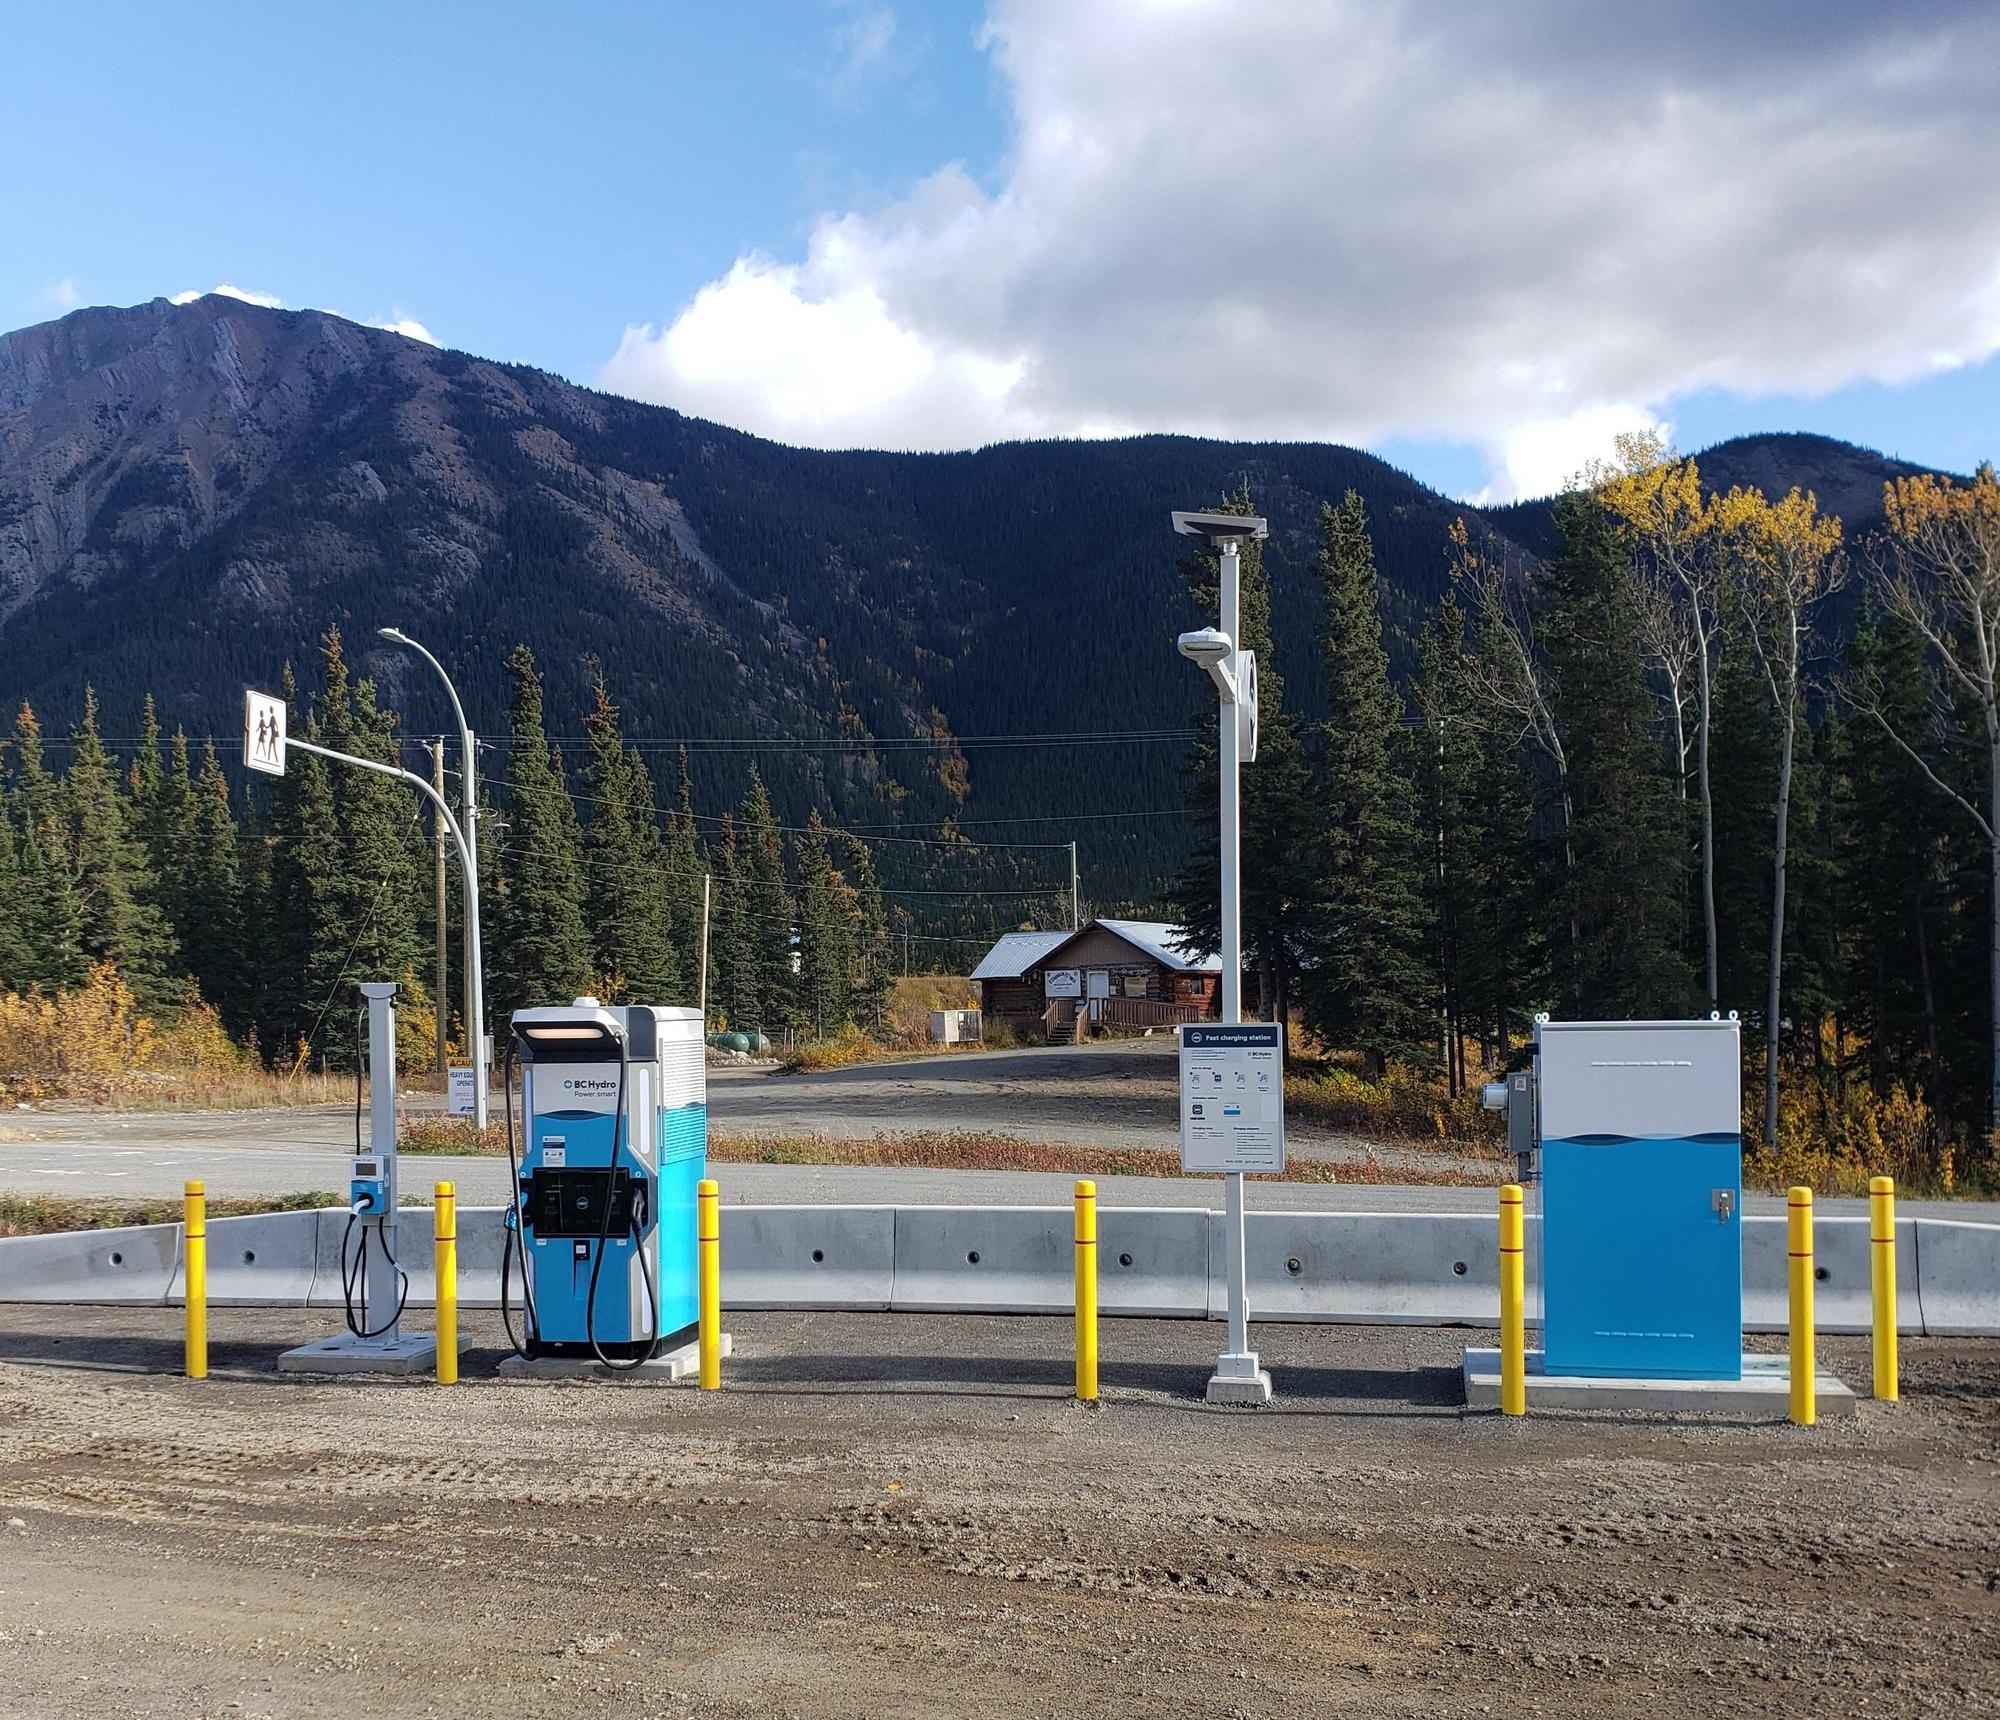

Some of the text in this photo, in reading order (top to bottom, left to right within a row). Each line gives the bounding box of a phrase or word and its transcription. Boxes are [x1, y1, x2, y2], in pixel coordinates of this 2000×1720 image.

[1220, 1034, 1248, 1042] charging
[574, 1080, 617, 1090] BC Hydro
